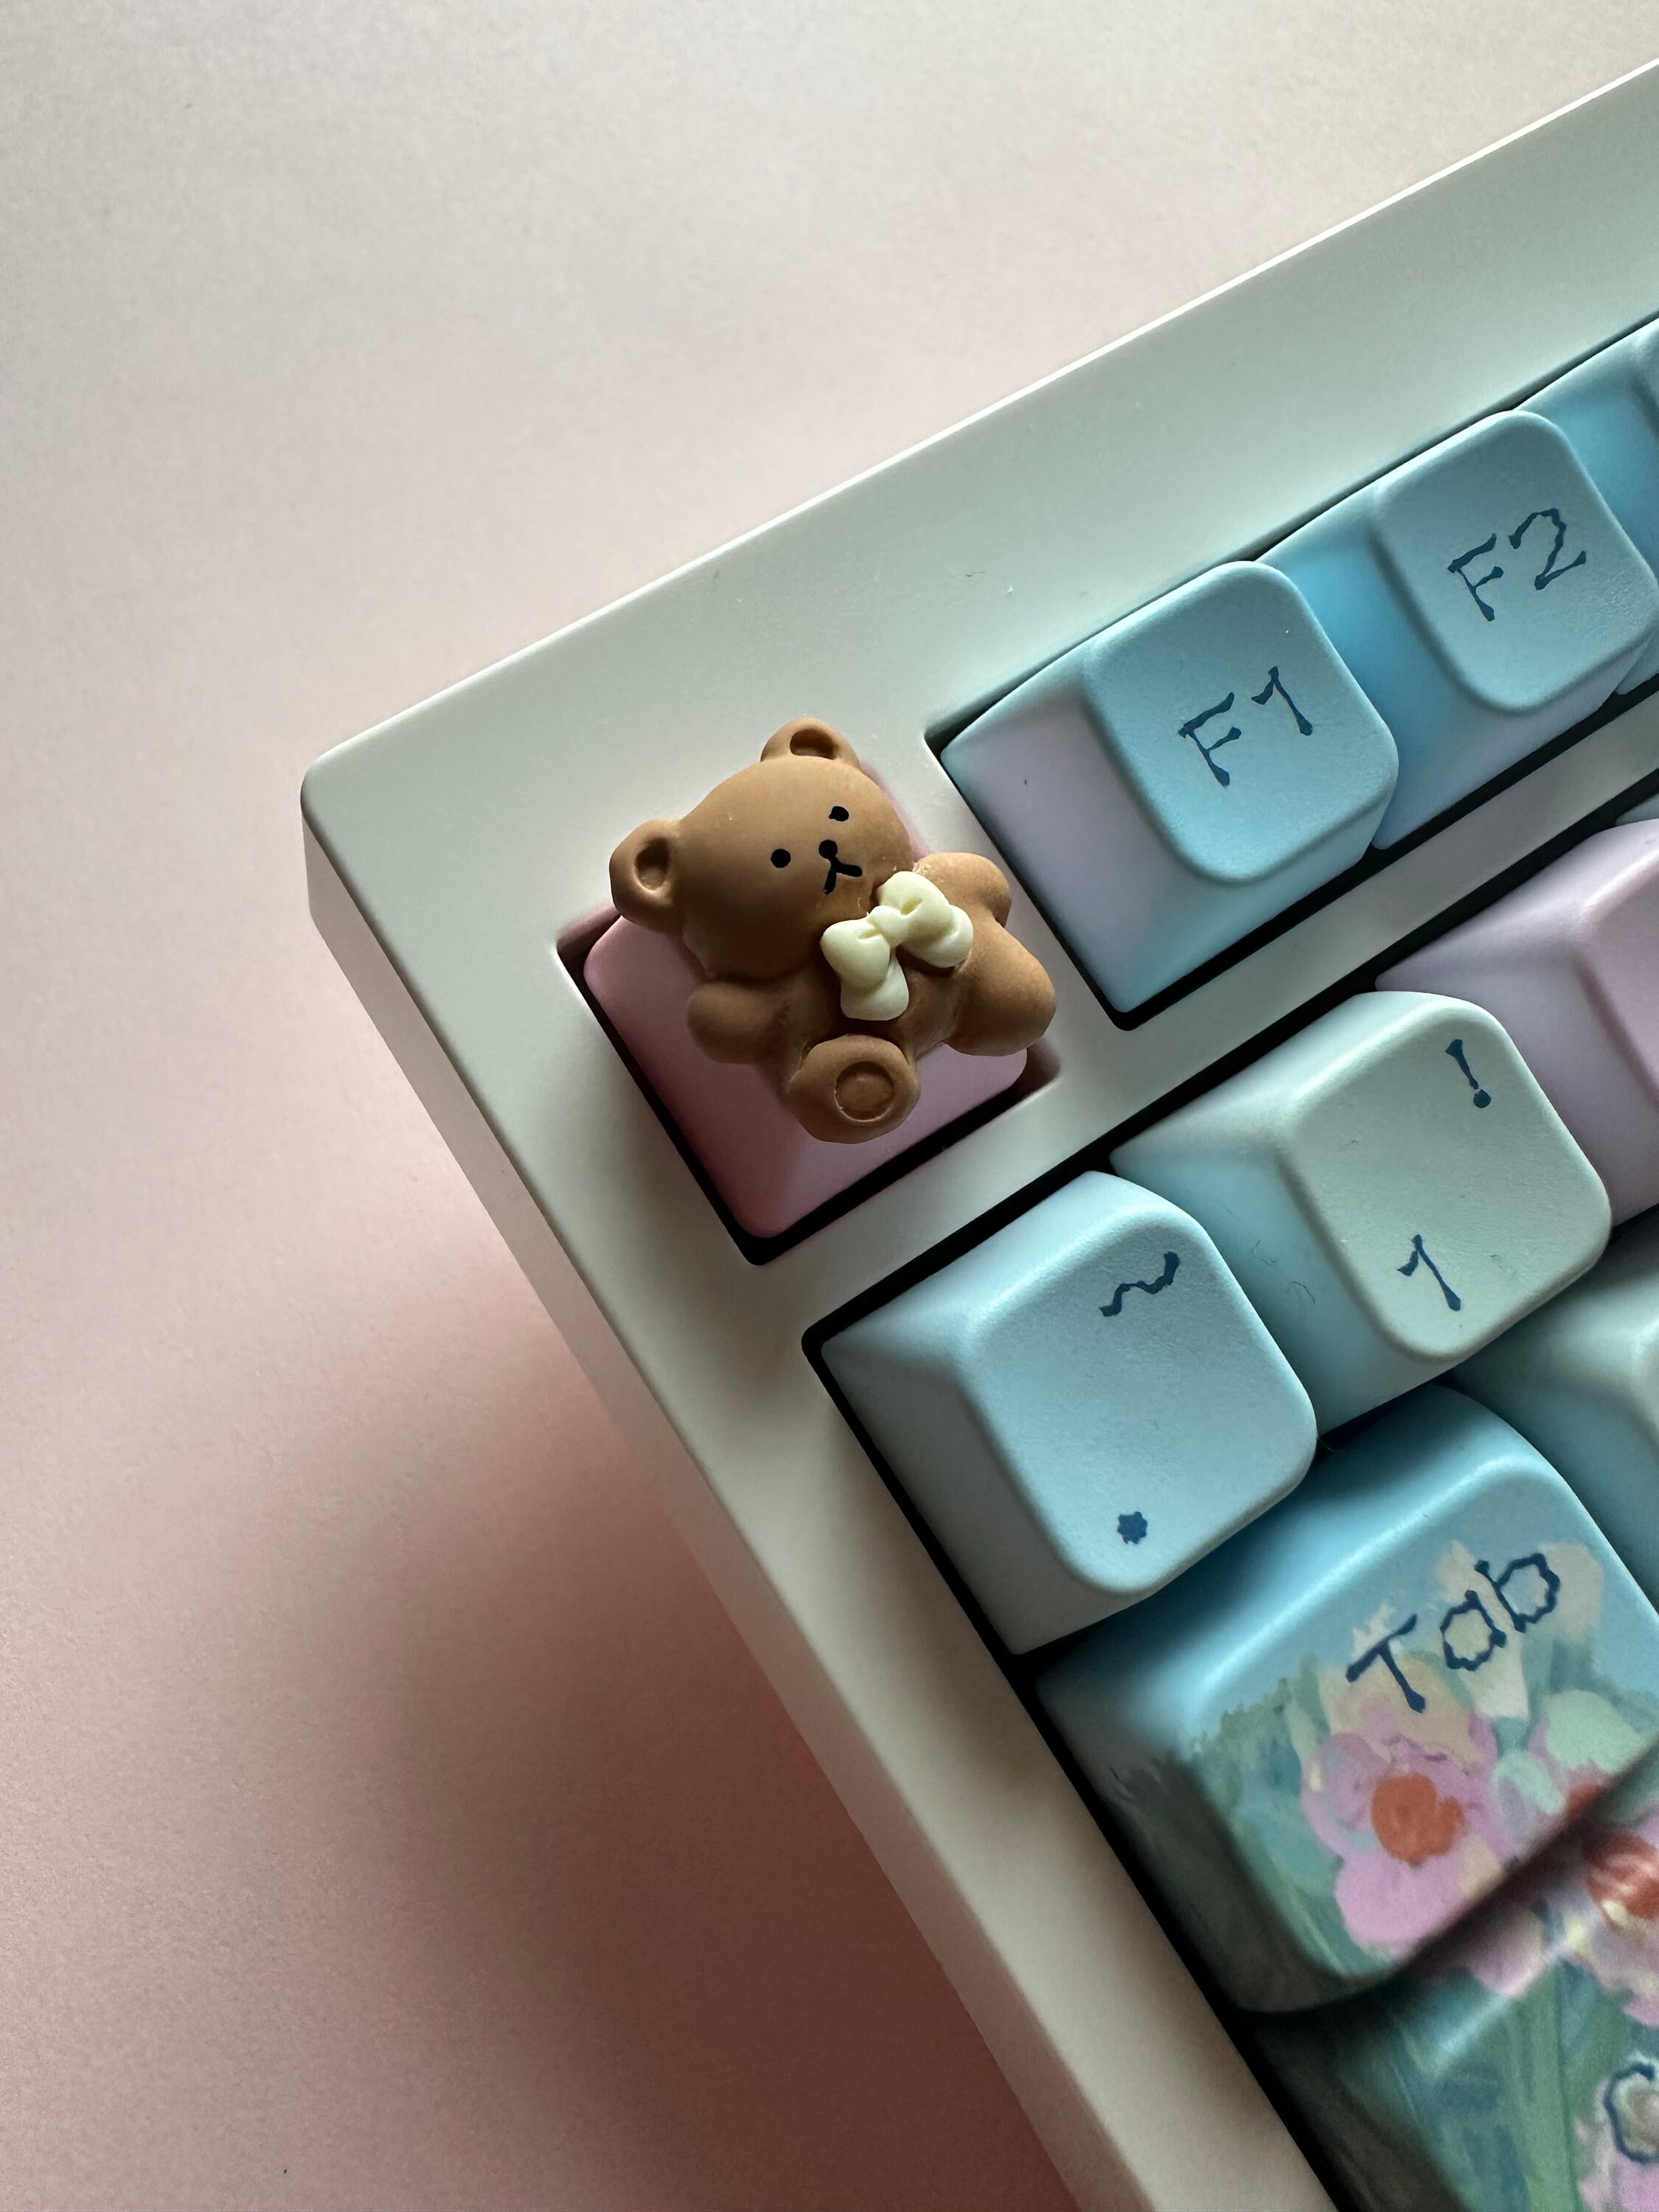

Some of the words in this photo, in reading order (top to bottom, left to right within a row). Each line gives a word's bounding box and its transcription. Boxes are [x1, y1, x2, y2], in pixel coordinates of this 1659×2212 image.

[1447, 508, 1586, 621] F2
[1179, 667, 1312, 787] F1
[1445, 1039, 1492, 1108] !
[1397, 1234, 1461, 1312] 1
[1346, 1553, 1561, 1714] Tab
